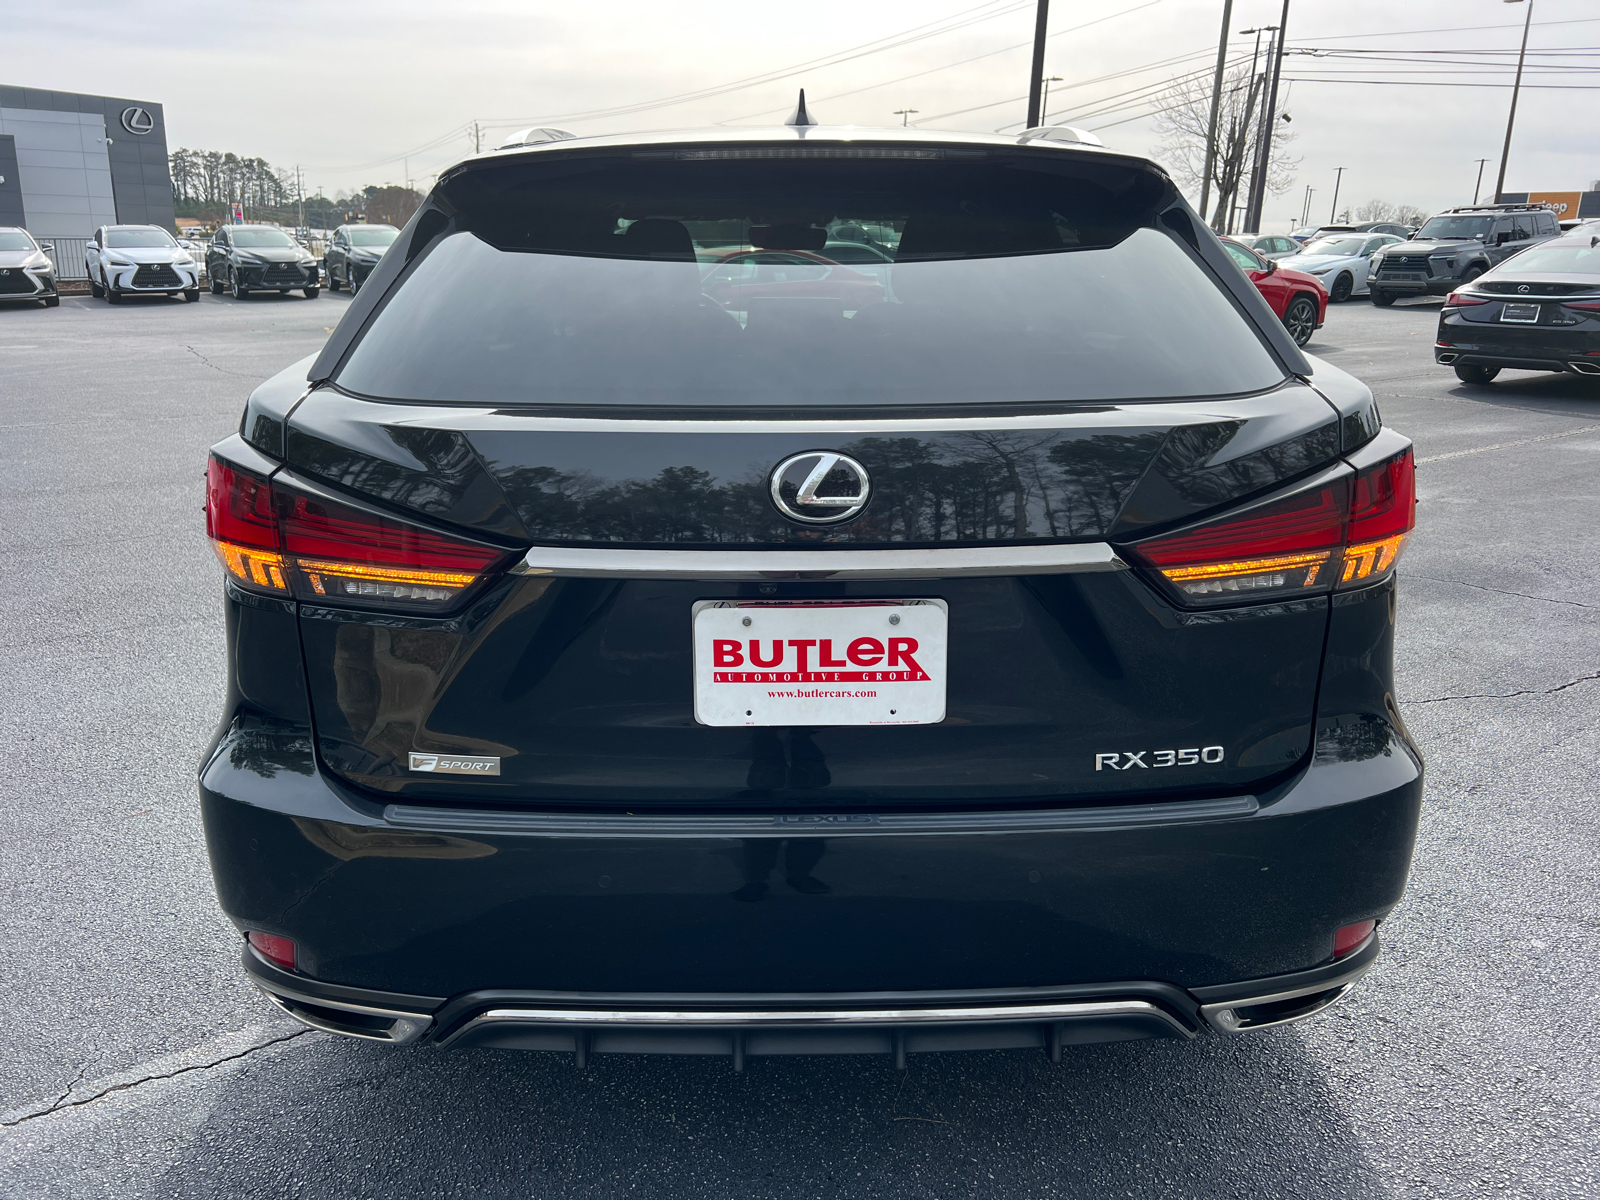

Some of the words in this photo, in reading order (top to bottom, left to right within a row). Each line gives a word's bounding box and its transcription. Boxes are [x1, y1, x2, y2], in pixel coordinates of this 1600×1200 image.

[714, 672, 840, 682] AUTOMOTIVE
[862, 671, 923, 681] GROUP
[767, 688, 878, 699] www.butlercars.com
[1095, 750, 1149, 771] RX
[1152, 746, 1225, 767] 350
[439, 760, 495, 771] SPORT
[781, 814, 872, 824] LEXUS
